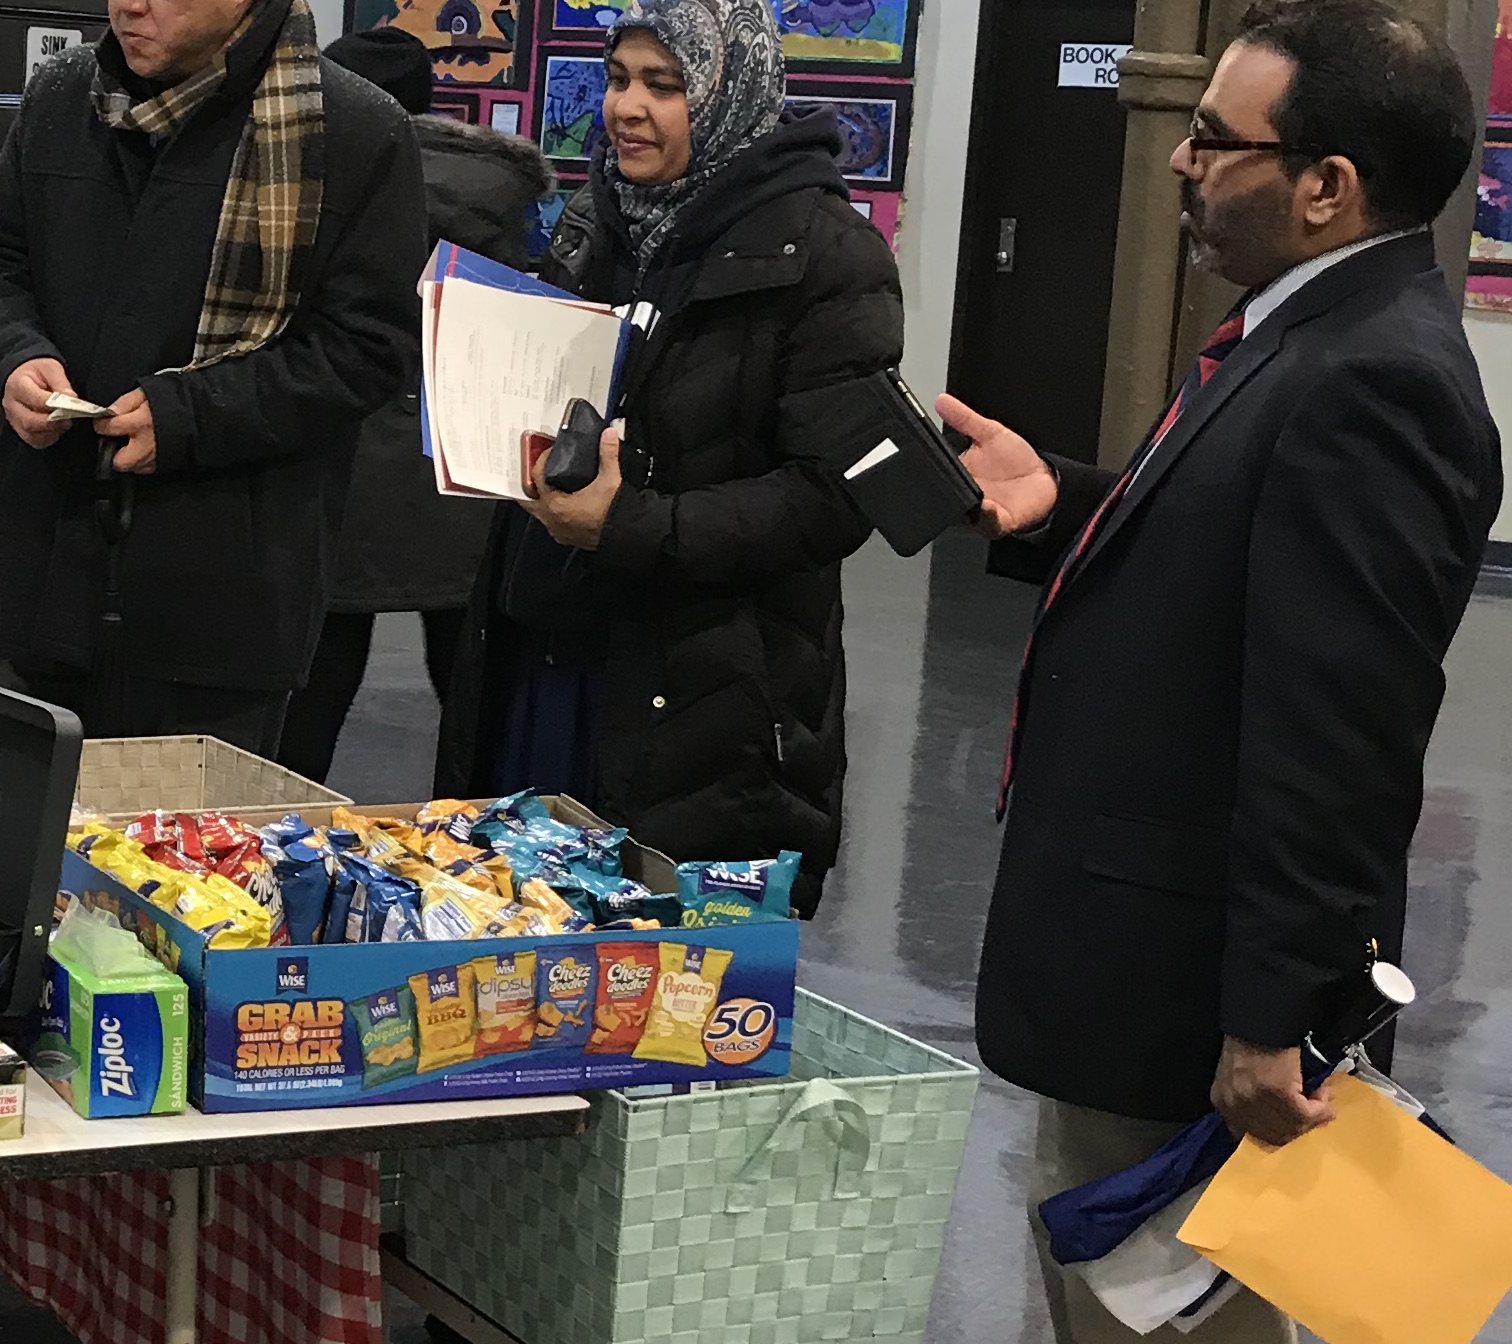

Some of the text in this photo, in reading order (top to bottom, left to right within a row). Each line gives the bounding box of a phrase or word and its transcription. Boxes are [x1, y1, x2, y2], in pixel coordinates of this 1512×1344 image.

[1062, 47, 1117, 65] BOOK
[1094, 68, 1120, 85] RO
[702, 901, 752, 918] golden
[495, 965, 516, 975] WISE
[549, 964, 592, 982] Cheez
[606, 963, 654, 982] Cheez
[279, 974, 305, 987] WISE
[430, 981, 457, 997] WISE
[479, 976, 535, 998] dipsy
[548, 978, 590, 993] doodles
[606, 978, 651, 993] doodles
[662, 974, 714, 998] Popcorn
[172, 993, 185, 1017] 125
[370, 1002, 397, 1017] WISE
[238, 1001, 344, 1031] GRAB
[426, 1008, 467, 1026] BBQ
[703, 1001, 775, 1041] 50
[282, 1024, 299, 1043] &
[236, 1038, 343, 1069] SNACK
[713, 1039, 761, 1053] BAGS
[98, 1017, 133, 1096] Ziploc
[248, 1067, 283, 1079] CALORIES
[284, 1067, 295, 1077] OR
[296, 1066, 314, 1077] LESS
[315, 1065, 329, 1075] PER
[330, 1064, 346, 1075] BAG
